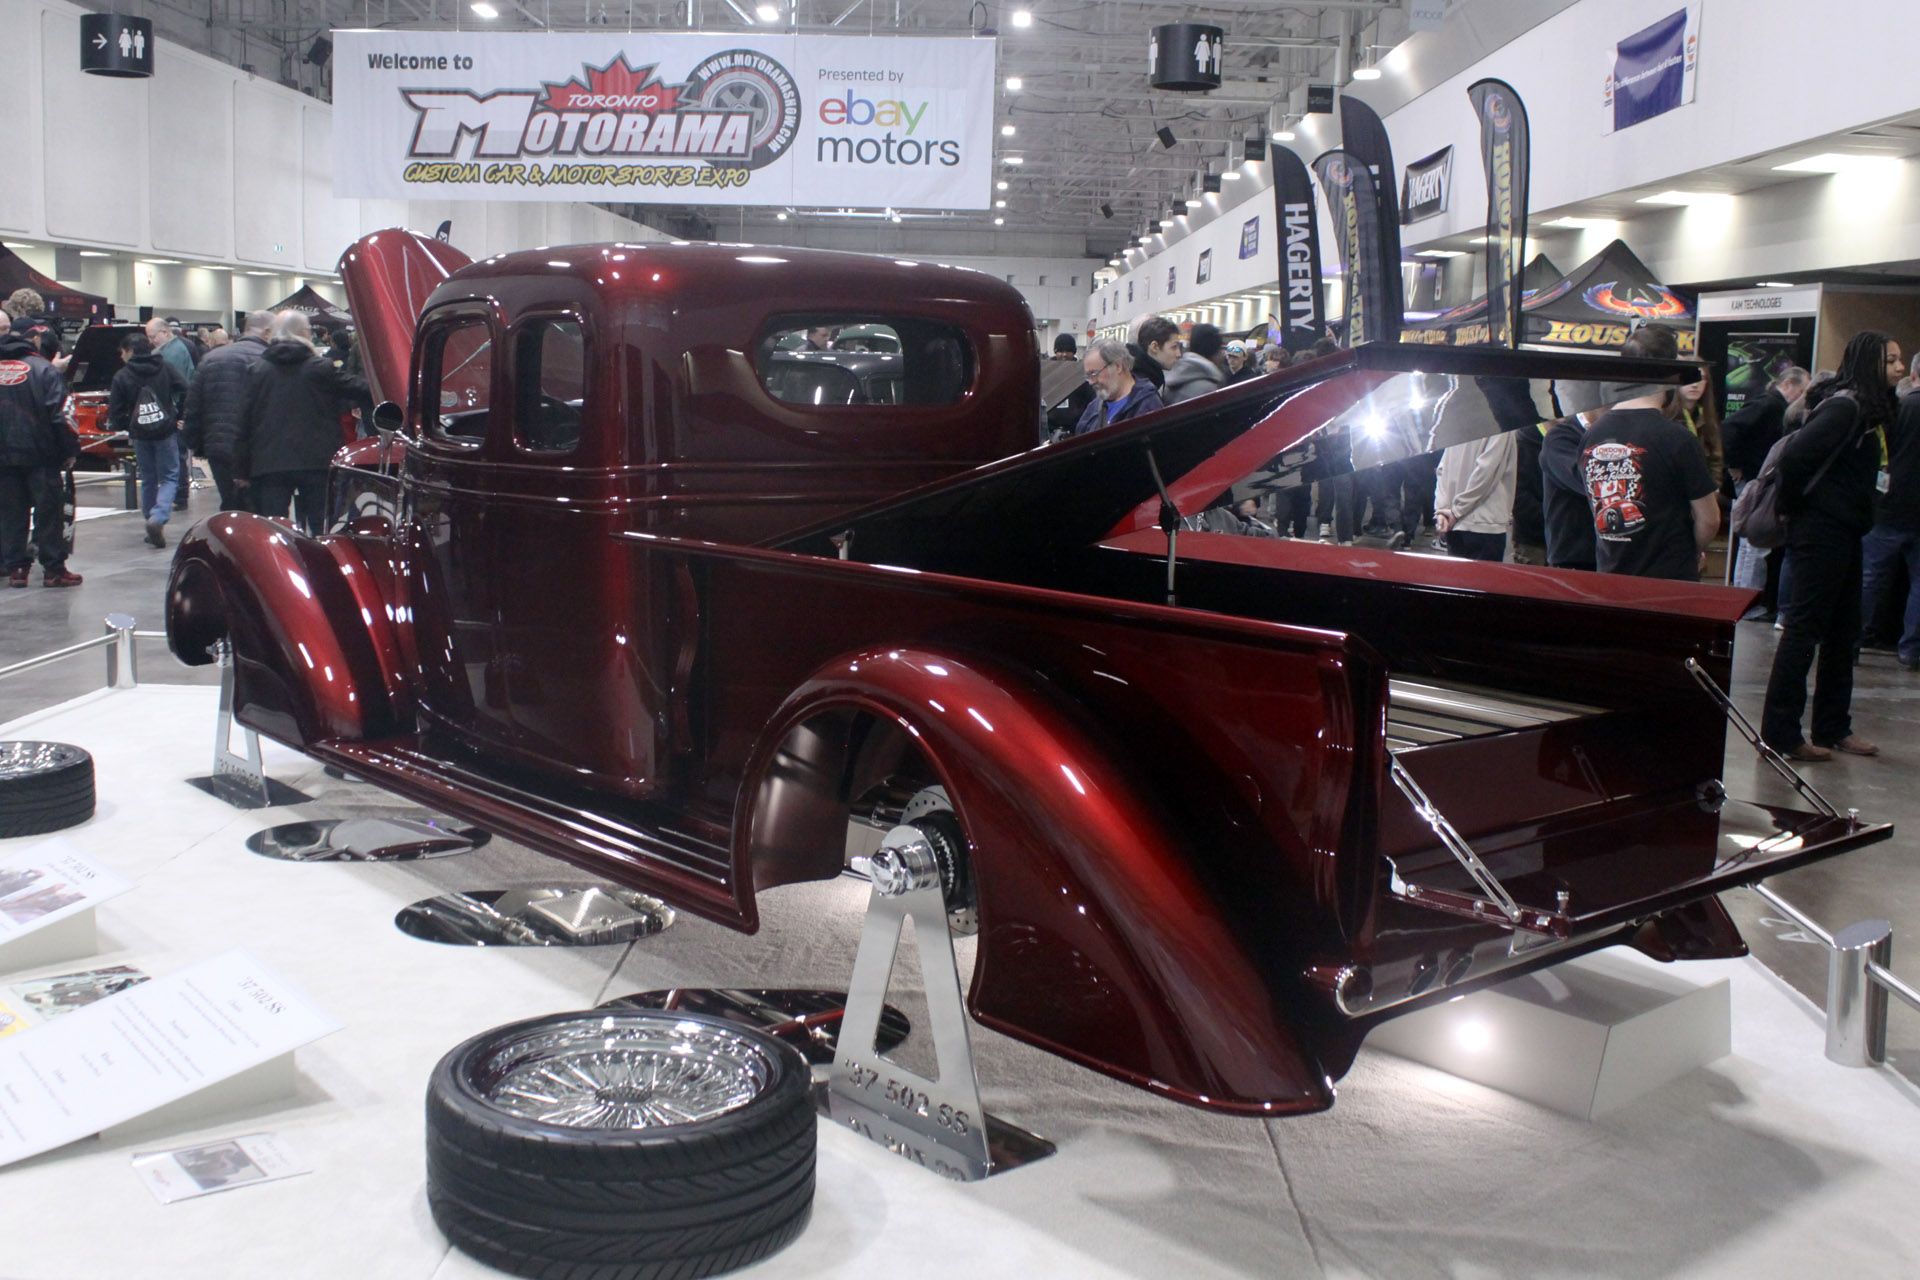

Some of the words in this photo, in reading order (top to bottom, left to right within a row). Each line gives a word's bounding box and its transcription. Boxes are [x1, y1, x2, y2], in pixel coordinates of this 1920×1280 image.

[368, 53, 447, 70] Welcome
[453, 54, 473, 70] to
[818, 68, 884, 81] Presented
[888, 69, 904, 83] by
[567, 94, 657, 108] TORONTO
[697, 54, 797, 152] WWW.MOTORAMASHOW.COM
[819, 89, 928, 135] ebay
[399, 87, 752, 160] MOTORAMA
[817, 131, 960, 166] motors
[403, 163, 480, 183] CUSTOM
[484, 164, 527, 185] CAR
[528, 165, 544, 187] &
[546, 164, 695, 187] MOTORSPORTS
[695, 165, 751, 189] EXPO
[1408, 163, 1447, 209] HAGERTY
[1284, 203, 1315, 331] HAGERTY
[1541, 320, 1629, 345] HOUS
[885, 1078, 930, 1117] 502
[937, 1103, 969, 1136] SS
